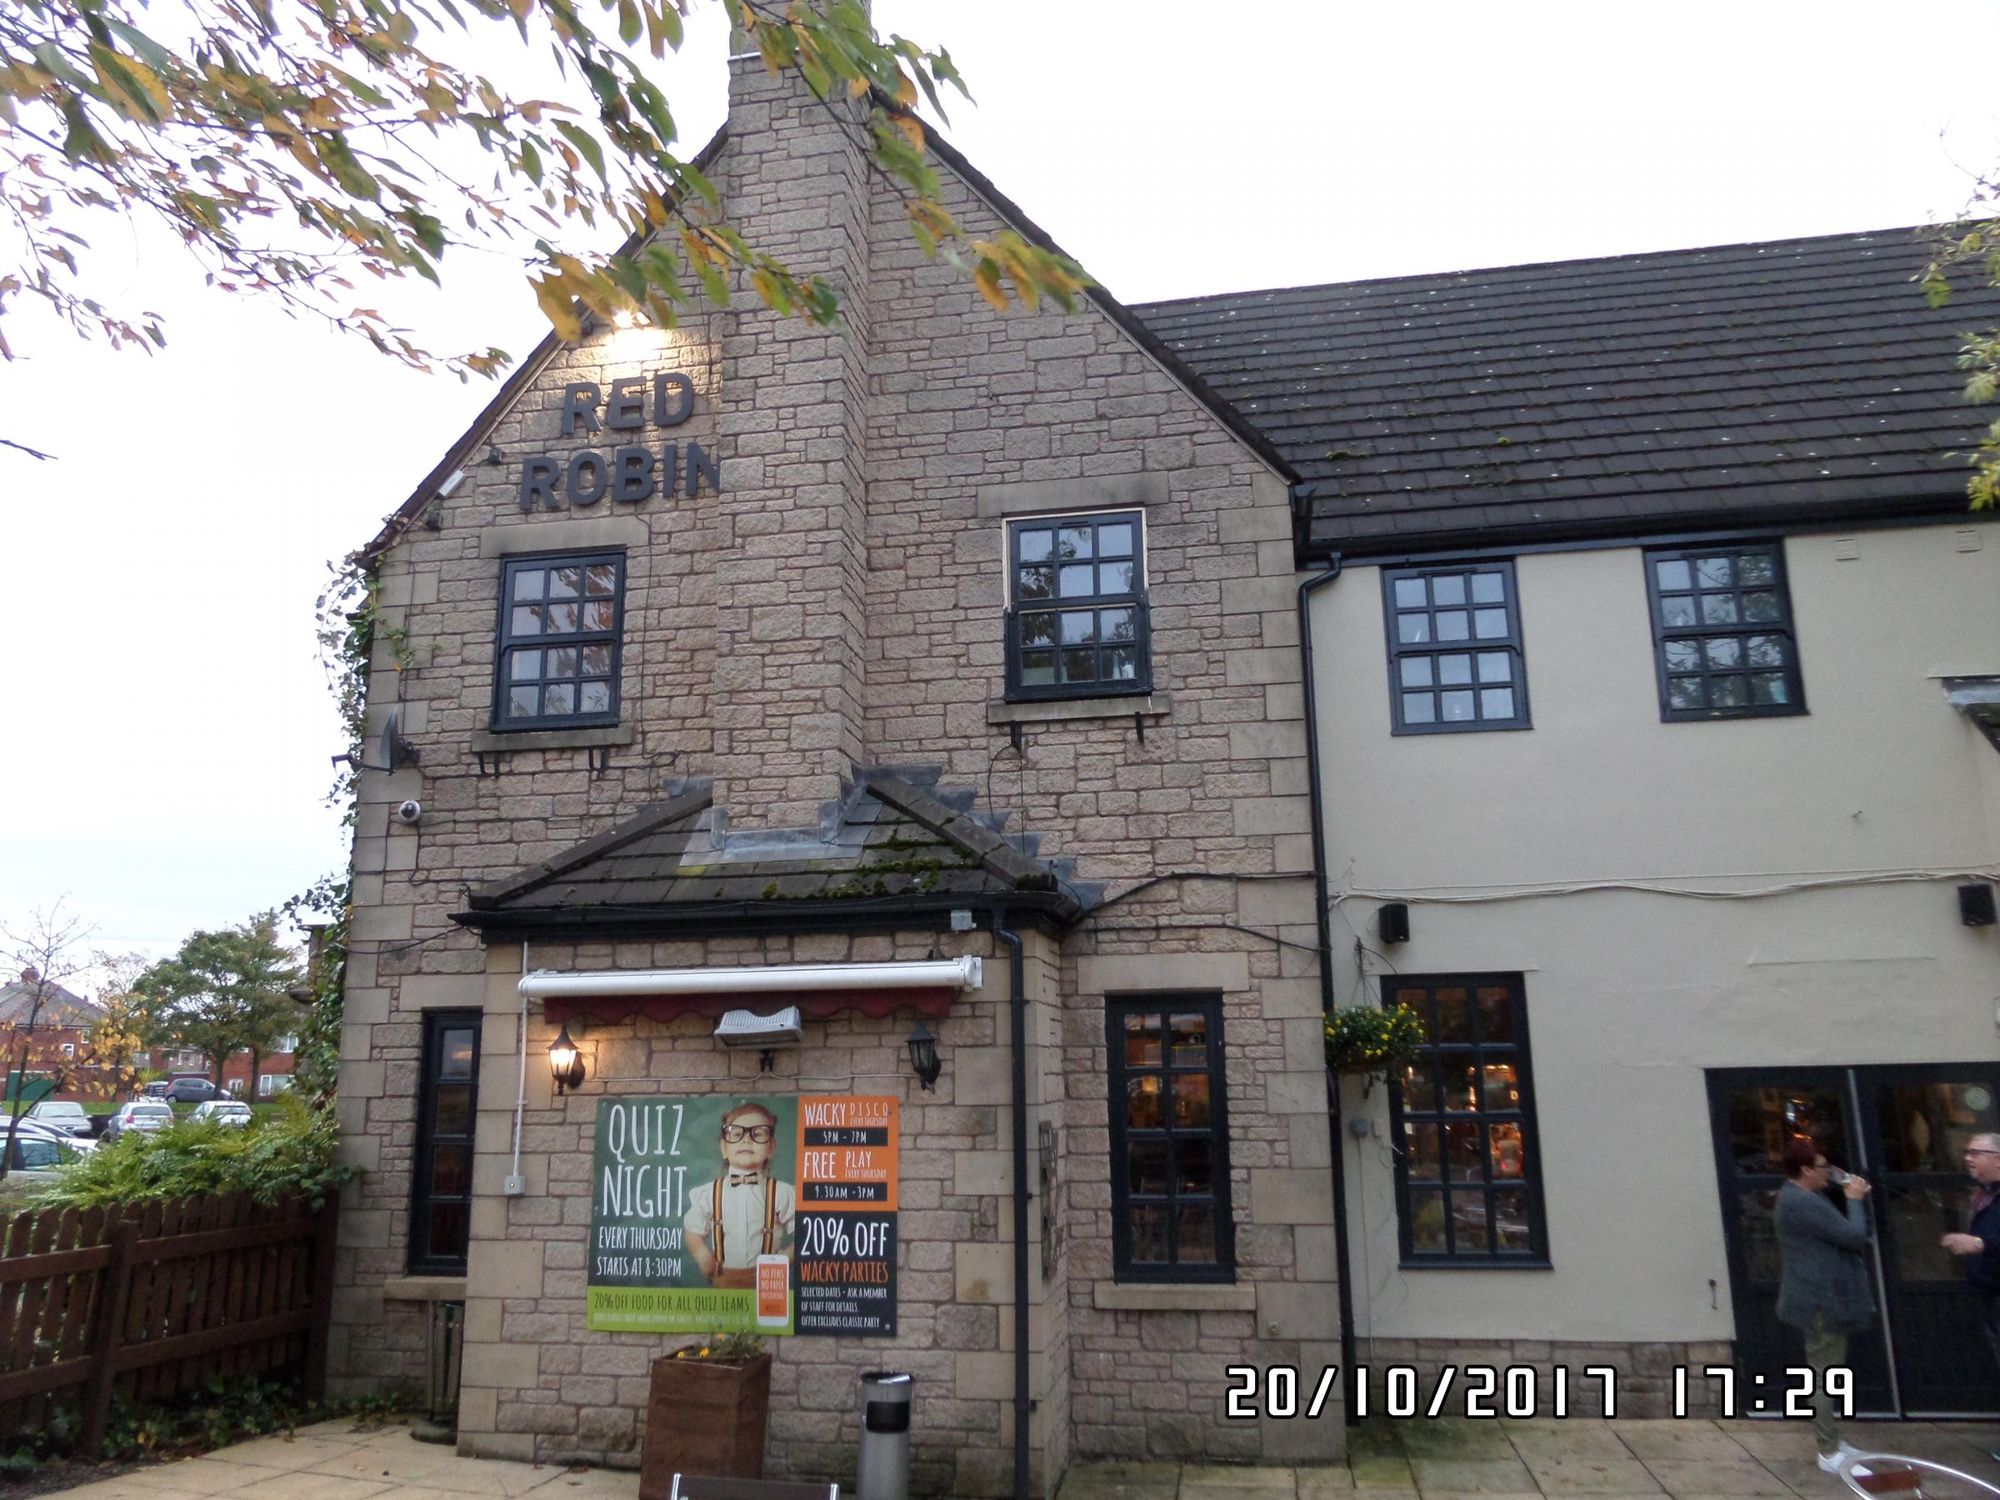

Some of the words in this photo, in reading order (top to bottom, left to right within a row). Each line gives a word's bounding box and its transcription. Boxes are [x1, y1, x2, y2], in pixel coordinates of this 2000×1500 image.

[562, 372, 694, 438] RED
[520, 441, 721, 512] ROBIN
[804, 1102, 847, 1126] WACKY
[850, 1102, 889, 1116] DISCO
[608, 1104, 684, 1163] QUIZ
[823, 1130, 839, 1143] 5PM
[851, 1130, 867, 1143] 7PM
[803, 1151, 837, 1179] FREE
[845, 1151, 872, 1168] PLAY
[861, 1169, 887, 1180] THURSDAY
[603, 1164, 687, 1219] NIGHT
[814, 1184, 848, 1198] 9.30AM
[598, 1226, 627, 1250] EVERY
[630, 1227, 683, 1251] THURSDAY
[801, 1216, 850, 1256] 20%
[854, 1222, 889, 1257] OFF
[596, 1256, 629, 1277] STARTS
[631, 1257, 644, 1276] AT
[645, 1257, 682, 1278] 8:30PM
[801, 1261, 840, 1282] WACKY
[843, 1261, 889, 1283] PARTIES
[594, 1292, 614, 1309] 20%
[614, 1294, 628, 1310] OFF
[631, 1295, 654, 1310] FOOD
[657, 1295, 672, 1311] FOR
[676, 1295, 691, 1311] ALL
[694, 1295, 717, 1313] QUIZ
[720, 1296, 750, 1312] TEAMS
[801, 1287, 825, 1297] SELECTED
[825, 1287, 841, 1297] DATES
[847, 1288, 858, 1298] ASK
[859, 1288, 863, 1298] A
[863, 1288, 887, 1298] MEMBER
[801, 1301, 809, 1311] OF
[809, 1301, 825, 1311] STAFF
[825, 1301, 835, 1312] FOR
[801, 1316, 817, 1326] OFFER
[817, 1316, 842, 1327] EXCLUDES
[842, 1317, 863, 1327] CLASSIC
[864, 1317, 880, 1328] PARTY
